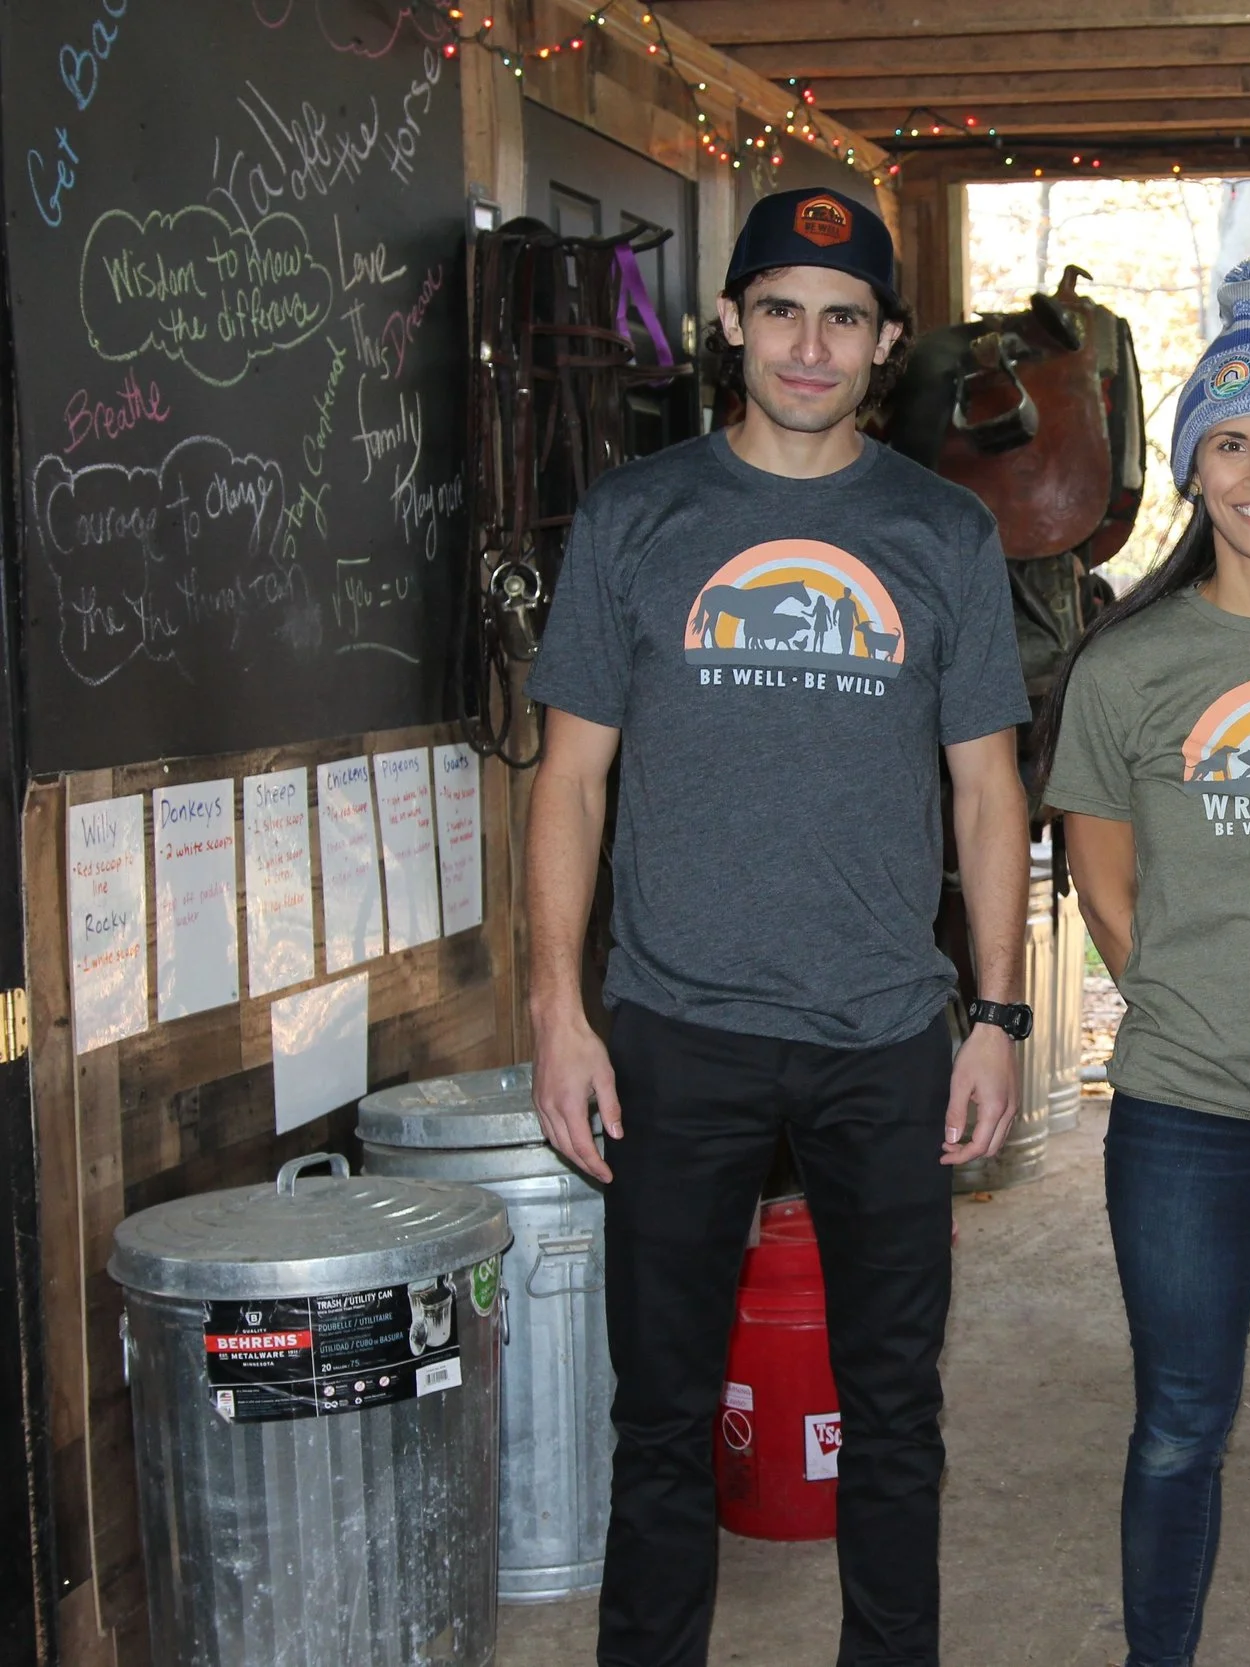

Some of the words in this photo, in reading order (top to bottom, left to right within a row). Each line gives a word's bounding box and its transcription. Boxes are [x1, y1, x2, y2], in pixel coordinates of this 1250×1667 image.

[290, 100, 331, 200] off
[329, 94, 378, 187] the
[27, 126, 79, 228] Get
[333, 213, 408, 292] Love
[103, 249, 208, 303] Wisdom
[206, 236, 239, 284] to
[158, 305, 208, 343] the
[63, 367, 171, 453] Breathe
[700, 668, 722, 685] BE
[733, 669, 786, 687] WELL
[804, 672, 826, 690] BE
[836, 675, 885, 696] WILD
[327, 765, 369, 790] Chickens
[381, 756, 420, 782] Pigeons
[256, 783, 296, 808] Sheep
[161, 797, 222, 828] Donkeys
[81, 811, 117, 848] Willy
[1215, 822, 1234, 836] BE
[176, 840, 203, 858] white
[205, 835, 233, 850] scoops
[92, 880, 108, 898] line
[85, 910, 127, 942] Rocky
[317, 1299, 341, 1310] TRASH
[349, 1293, 376, 1305] UTILITY
[378, 1289, 393, 1300] CAN
[318, 1319, 352, 1332] POUBELLE
[359, 1312, 393, 1326] UTILITAIRE
[217, 1334, 297, 1349] BEHRENS
[320, 1342, 349, 1354] UTILIDAD
[355, 1338, 373, 1348] CUBO
[379, 1331, 404, 1344] BASURA
[231, 1351, 284, 1360] METALWARE
[321, 1363, 332, 1372] 20
